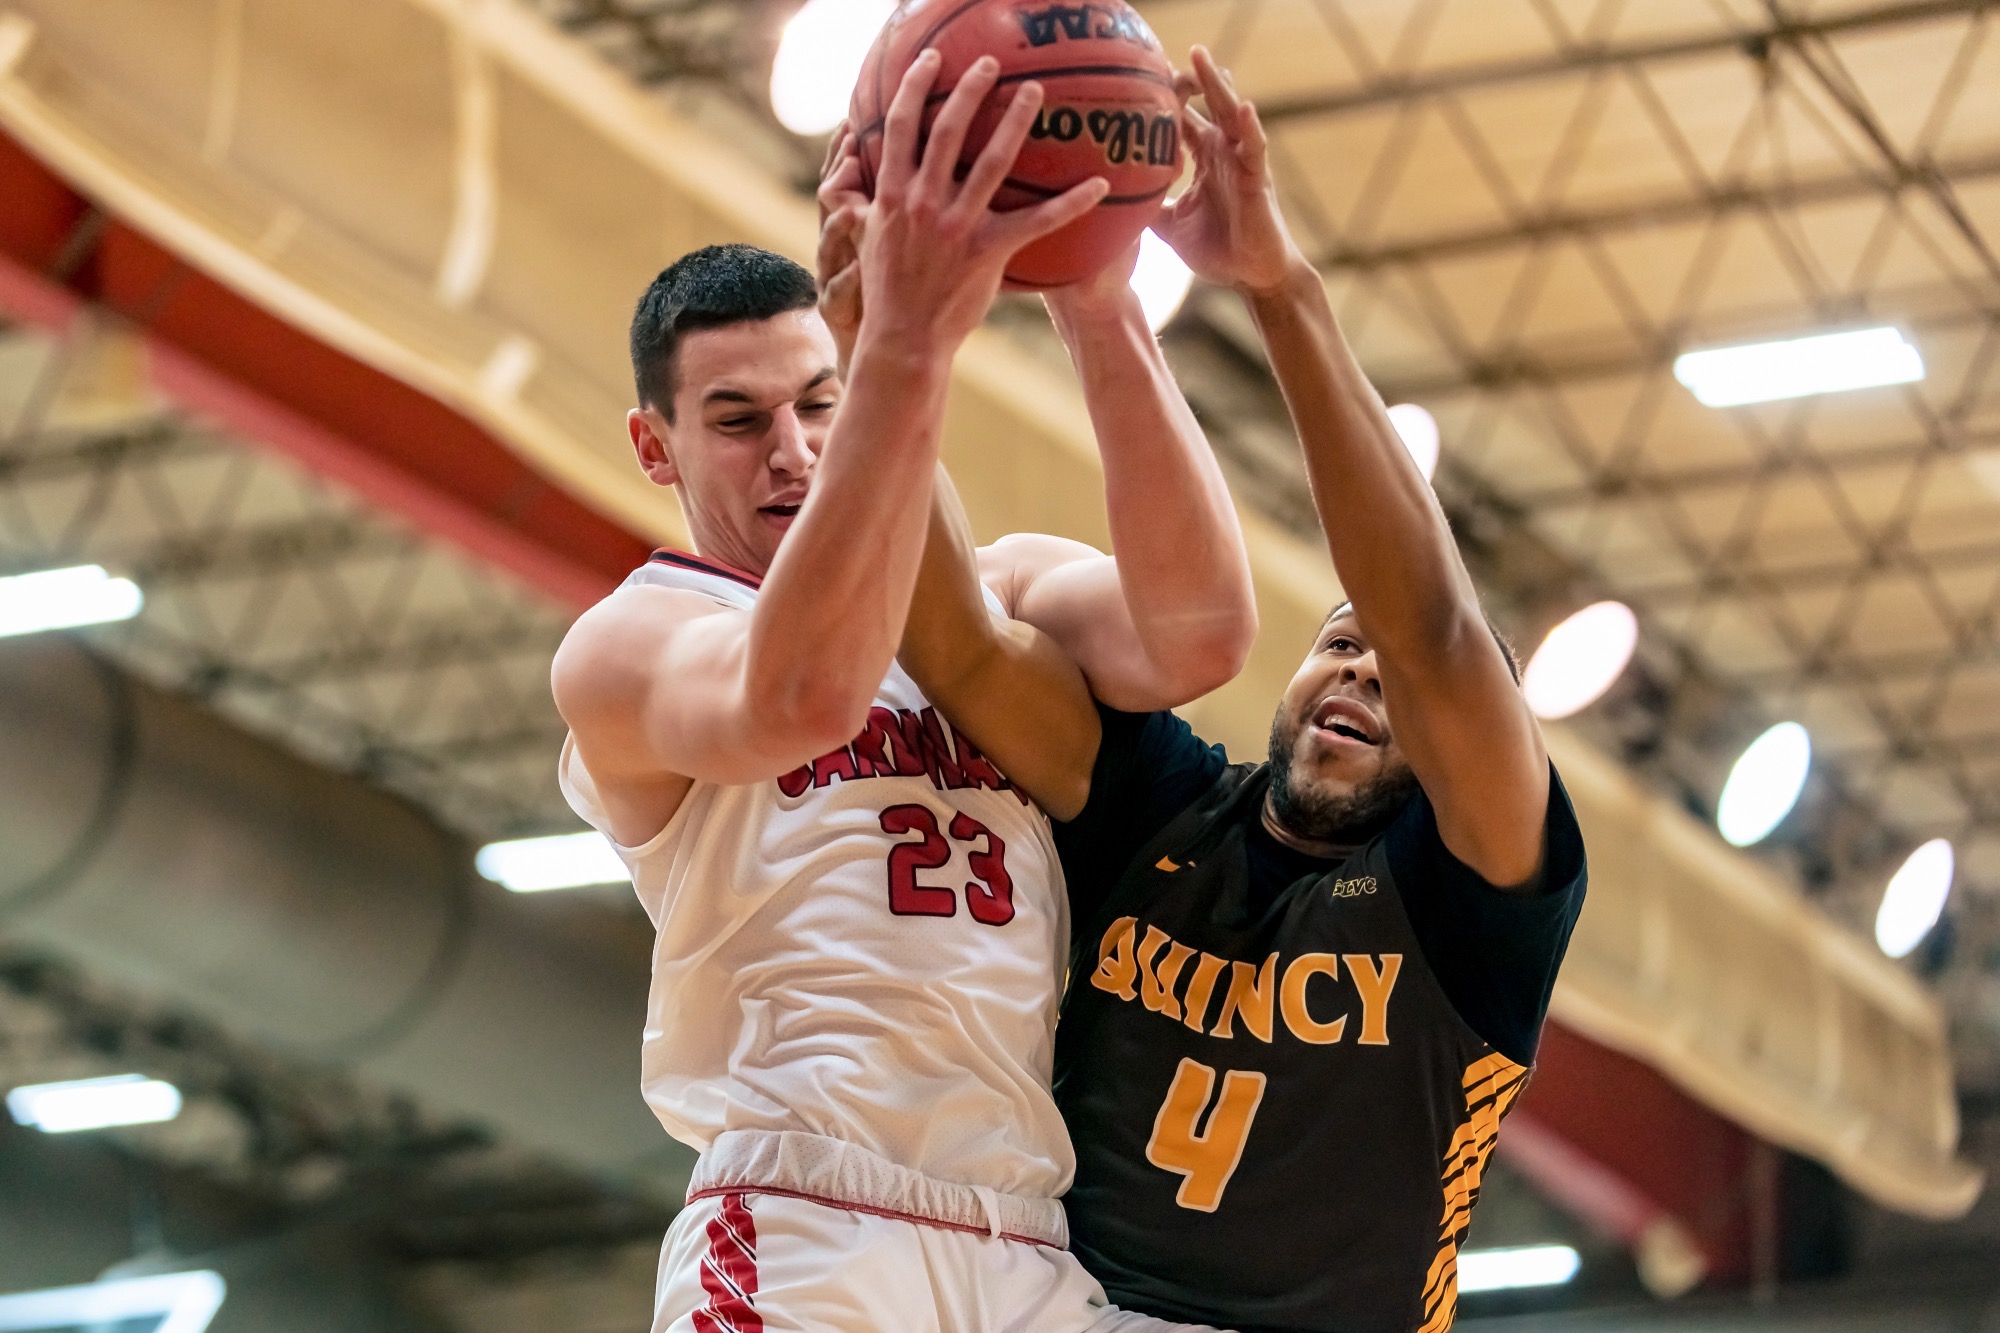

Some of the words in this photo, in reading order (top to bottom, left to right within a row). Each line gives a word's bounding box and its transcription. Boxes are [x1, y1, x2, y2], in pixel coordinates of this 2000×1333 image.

[879, 803, 1016, 926] 23
[1091, 915, 1403, 1046] QUINCY
[1146, 1057, 1267, 1213] 4
